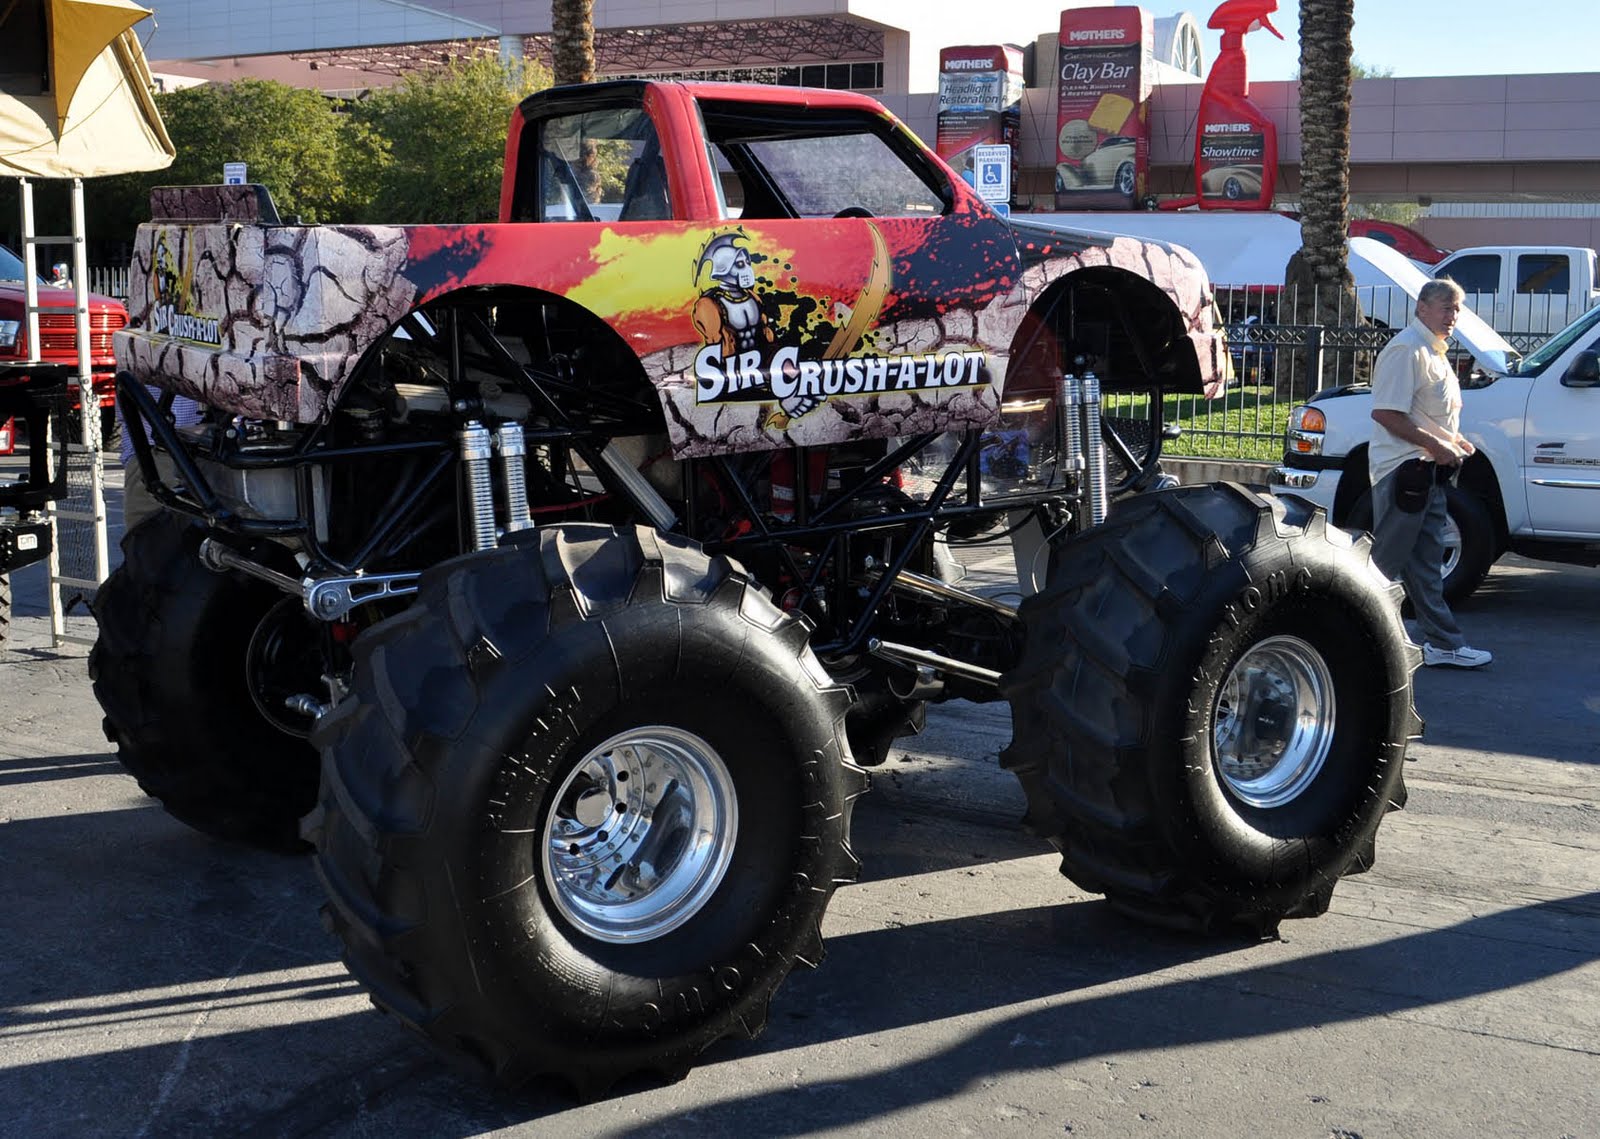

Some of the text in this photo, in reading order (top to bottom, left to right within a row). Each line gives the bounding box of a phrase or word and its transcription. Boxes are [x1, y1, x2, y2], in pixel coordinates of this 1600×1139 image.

[1069, 29, 1126, 41] MOTHERS
[944, 59, 994, 70] MOTHERS
[1061, 62, 1134, 83] Clay Bar
[944, 83, 992, 96] Headlight
[940, 95, 999, 104] Restoration
[1205, 123, 1251, 133] MOTHERS
[1201, 146, 1259, 157] Showtime
[154, 301, 219, 343] SIR CRUSH-A-LOT
[695, 344, 986, 402] SIR CRUSH-A-LOT
